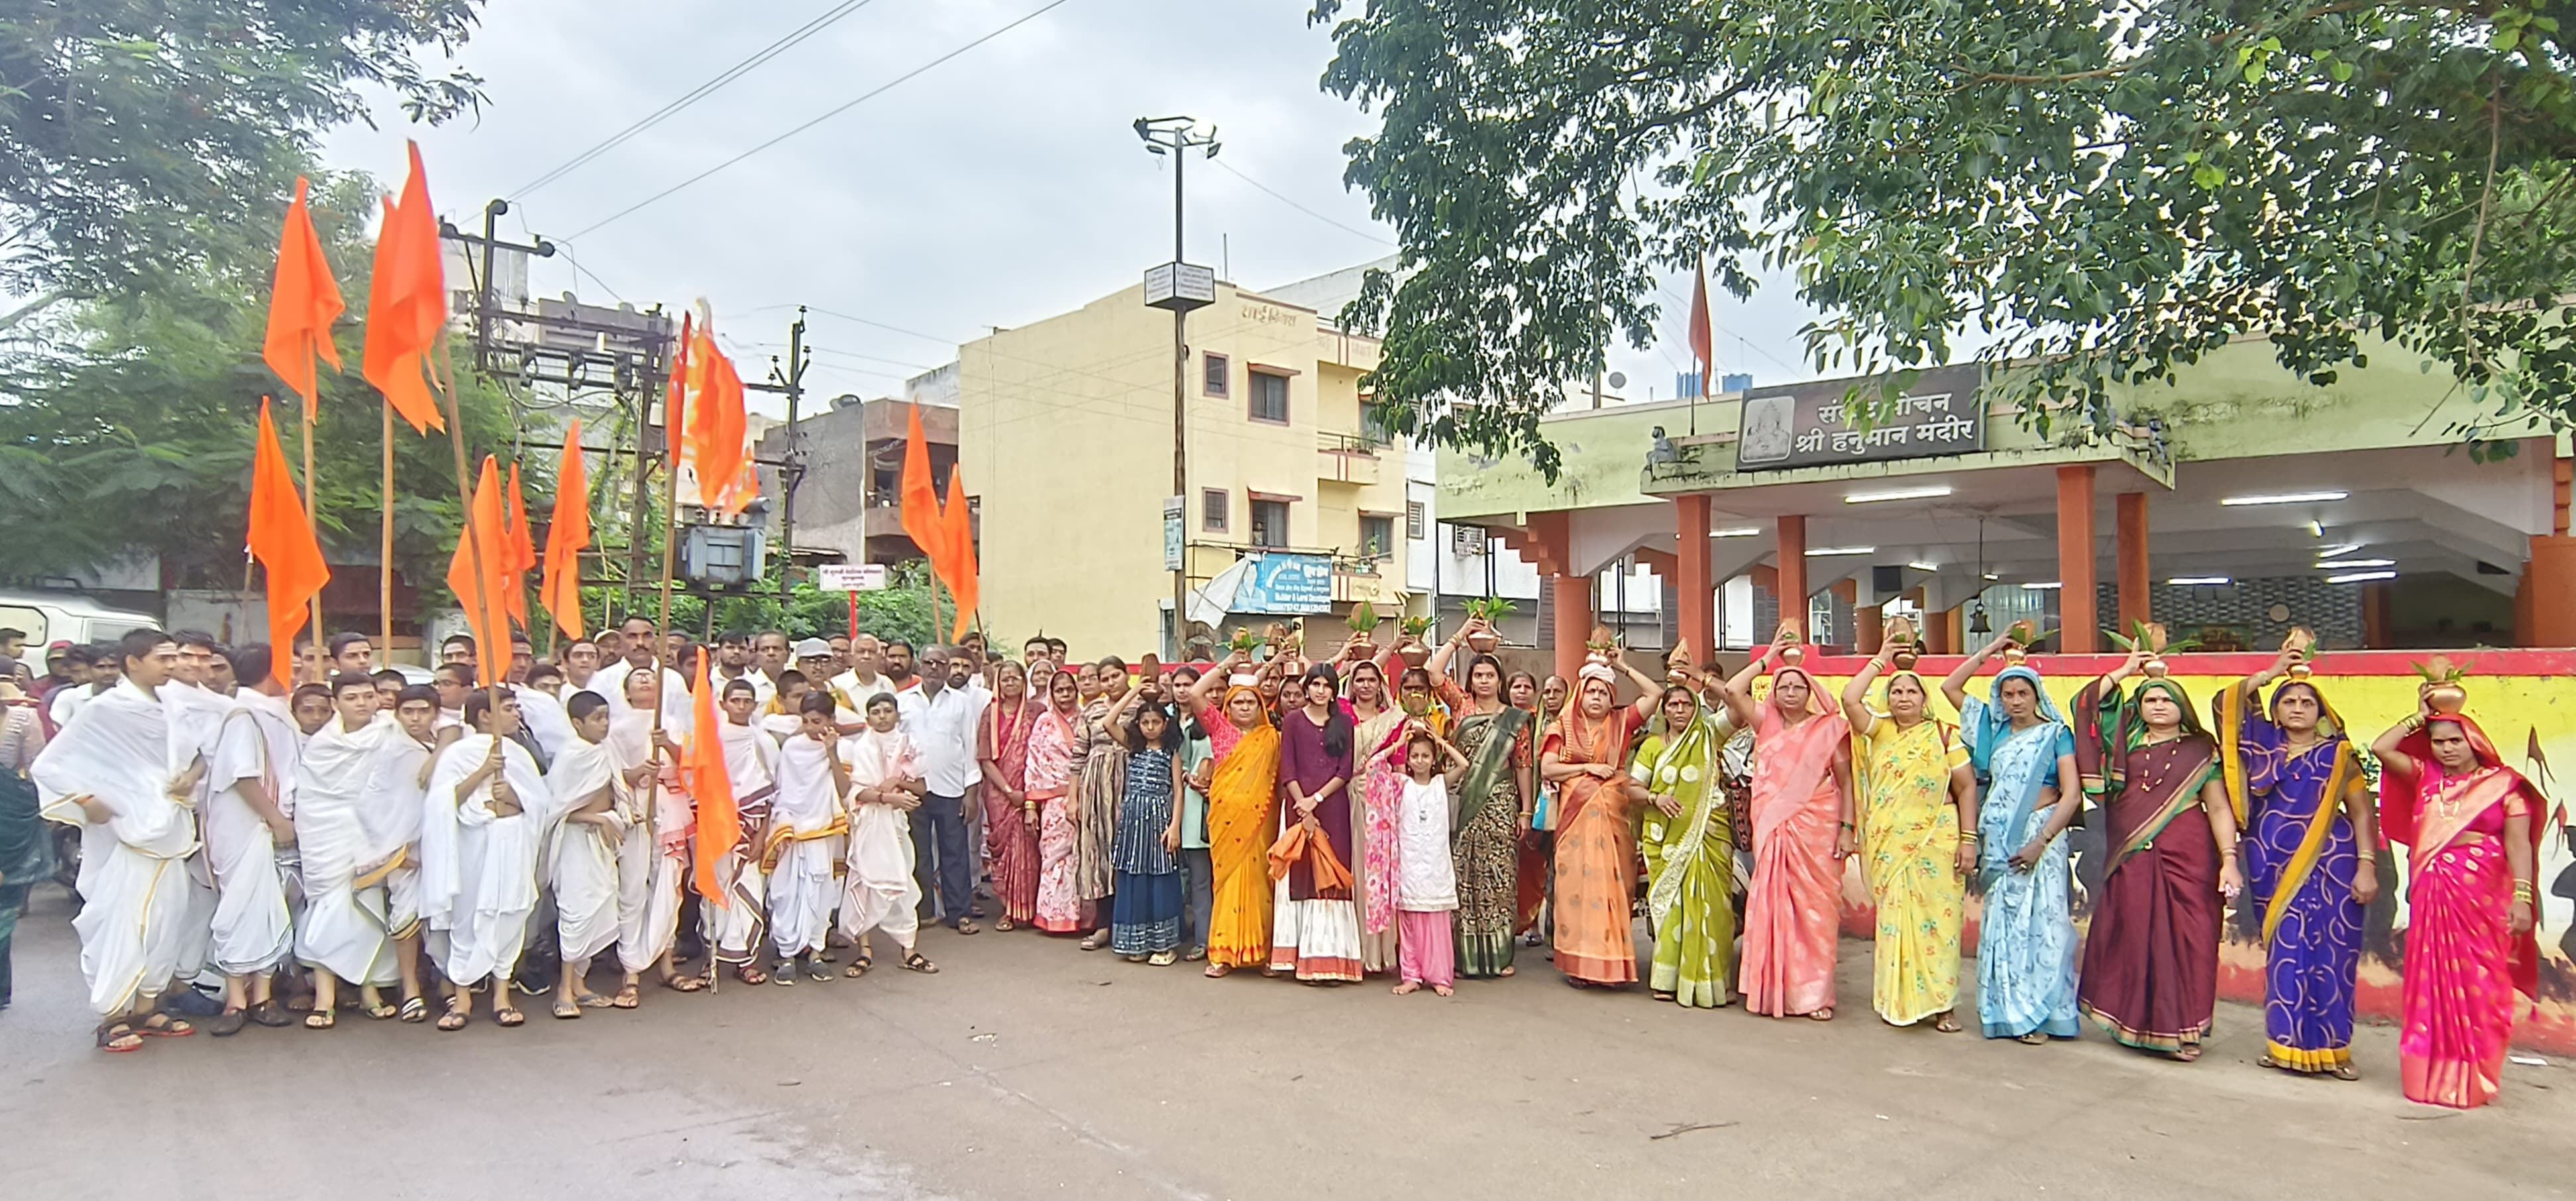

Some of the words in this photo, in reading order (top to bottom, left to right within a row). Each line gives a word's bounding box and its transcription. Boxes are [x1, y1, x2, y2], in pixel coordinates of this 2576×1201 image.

[1795, 428, 1825, 453] श्री
[1831, 426, 1909, 455] हनुमान
[1915, 414, 1974, 443] मंदीर
